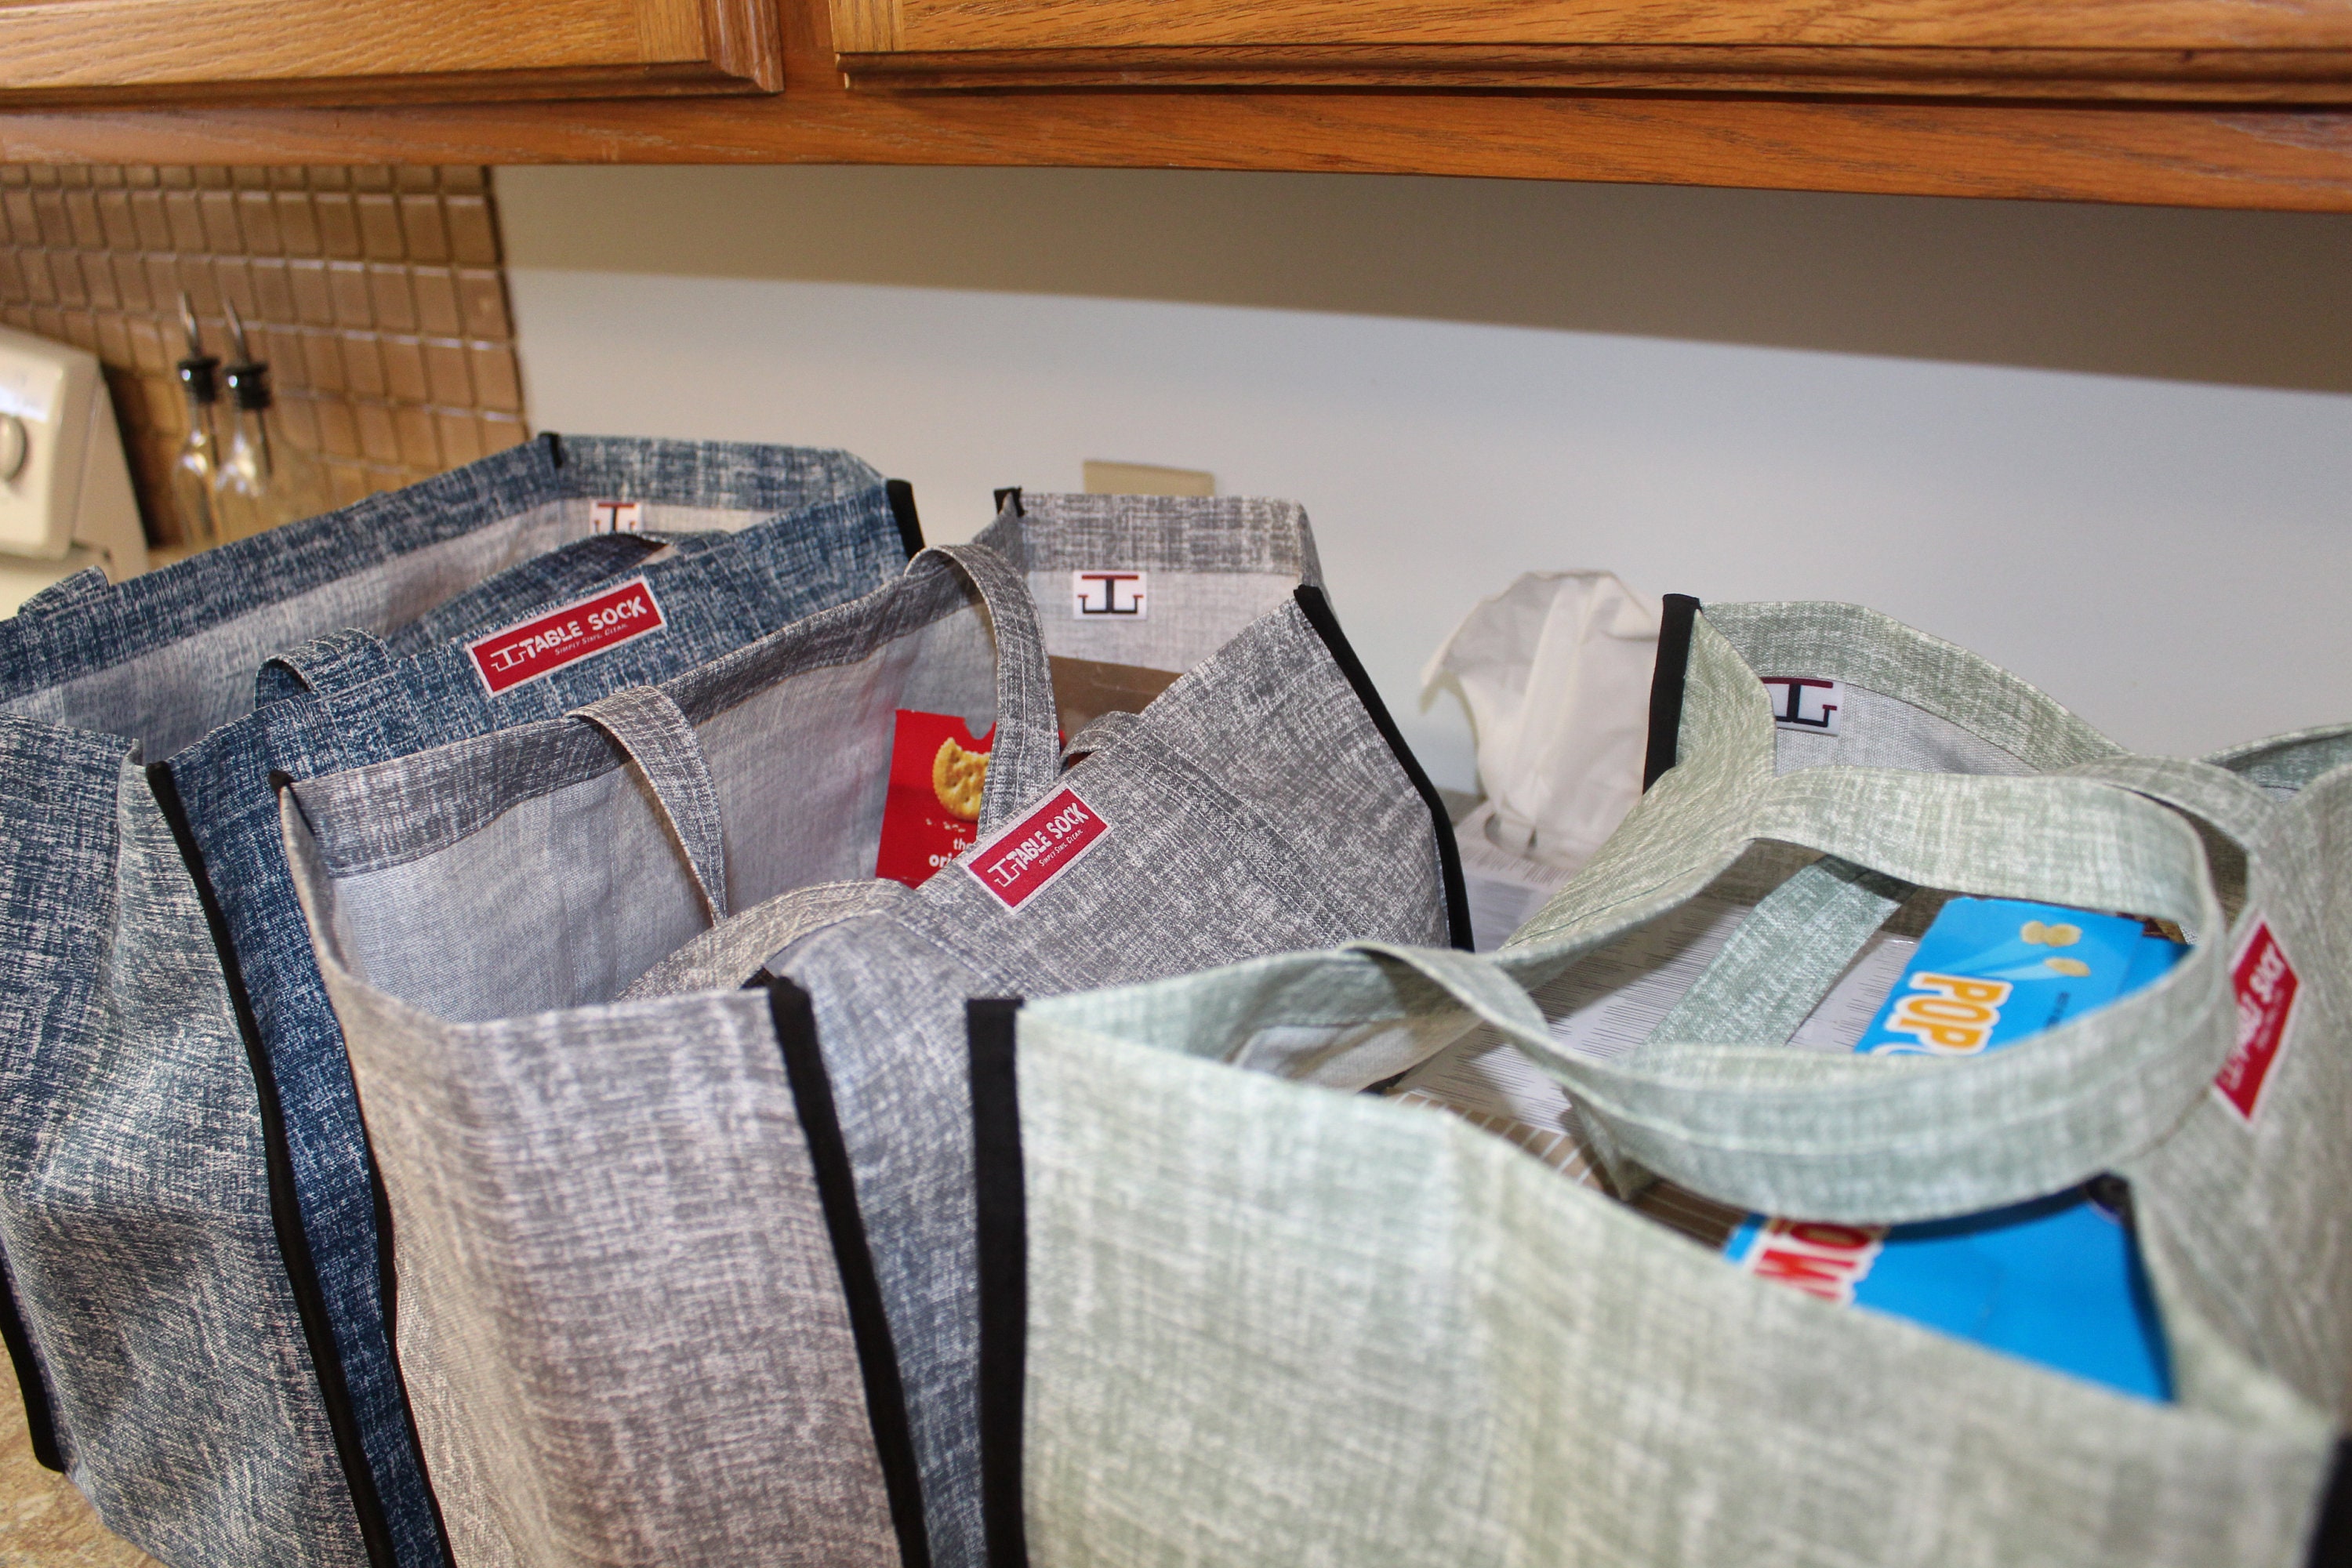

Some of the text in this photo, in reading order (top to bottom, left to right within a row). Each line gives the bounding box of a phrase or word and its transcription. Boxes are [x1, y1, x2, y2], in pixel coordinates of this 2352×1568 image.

[518, 596, 647, 659] TABLE SOCK
[554, 641, 580, 655] SIMPLY
[1005, 803, 1089, 870] TABLE SOCK
[1038, 850, 1056, 867] SIMPLY
[1892, 974, 2009, 1052] POP
